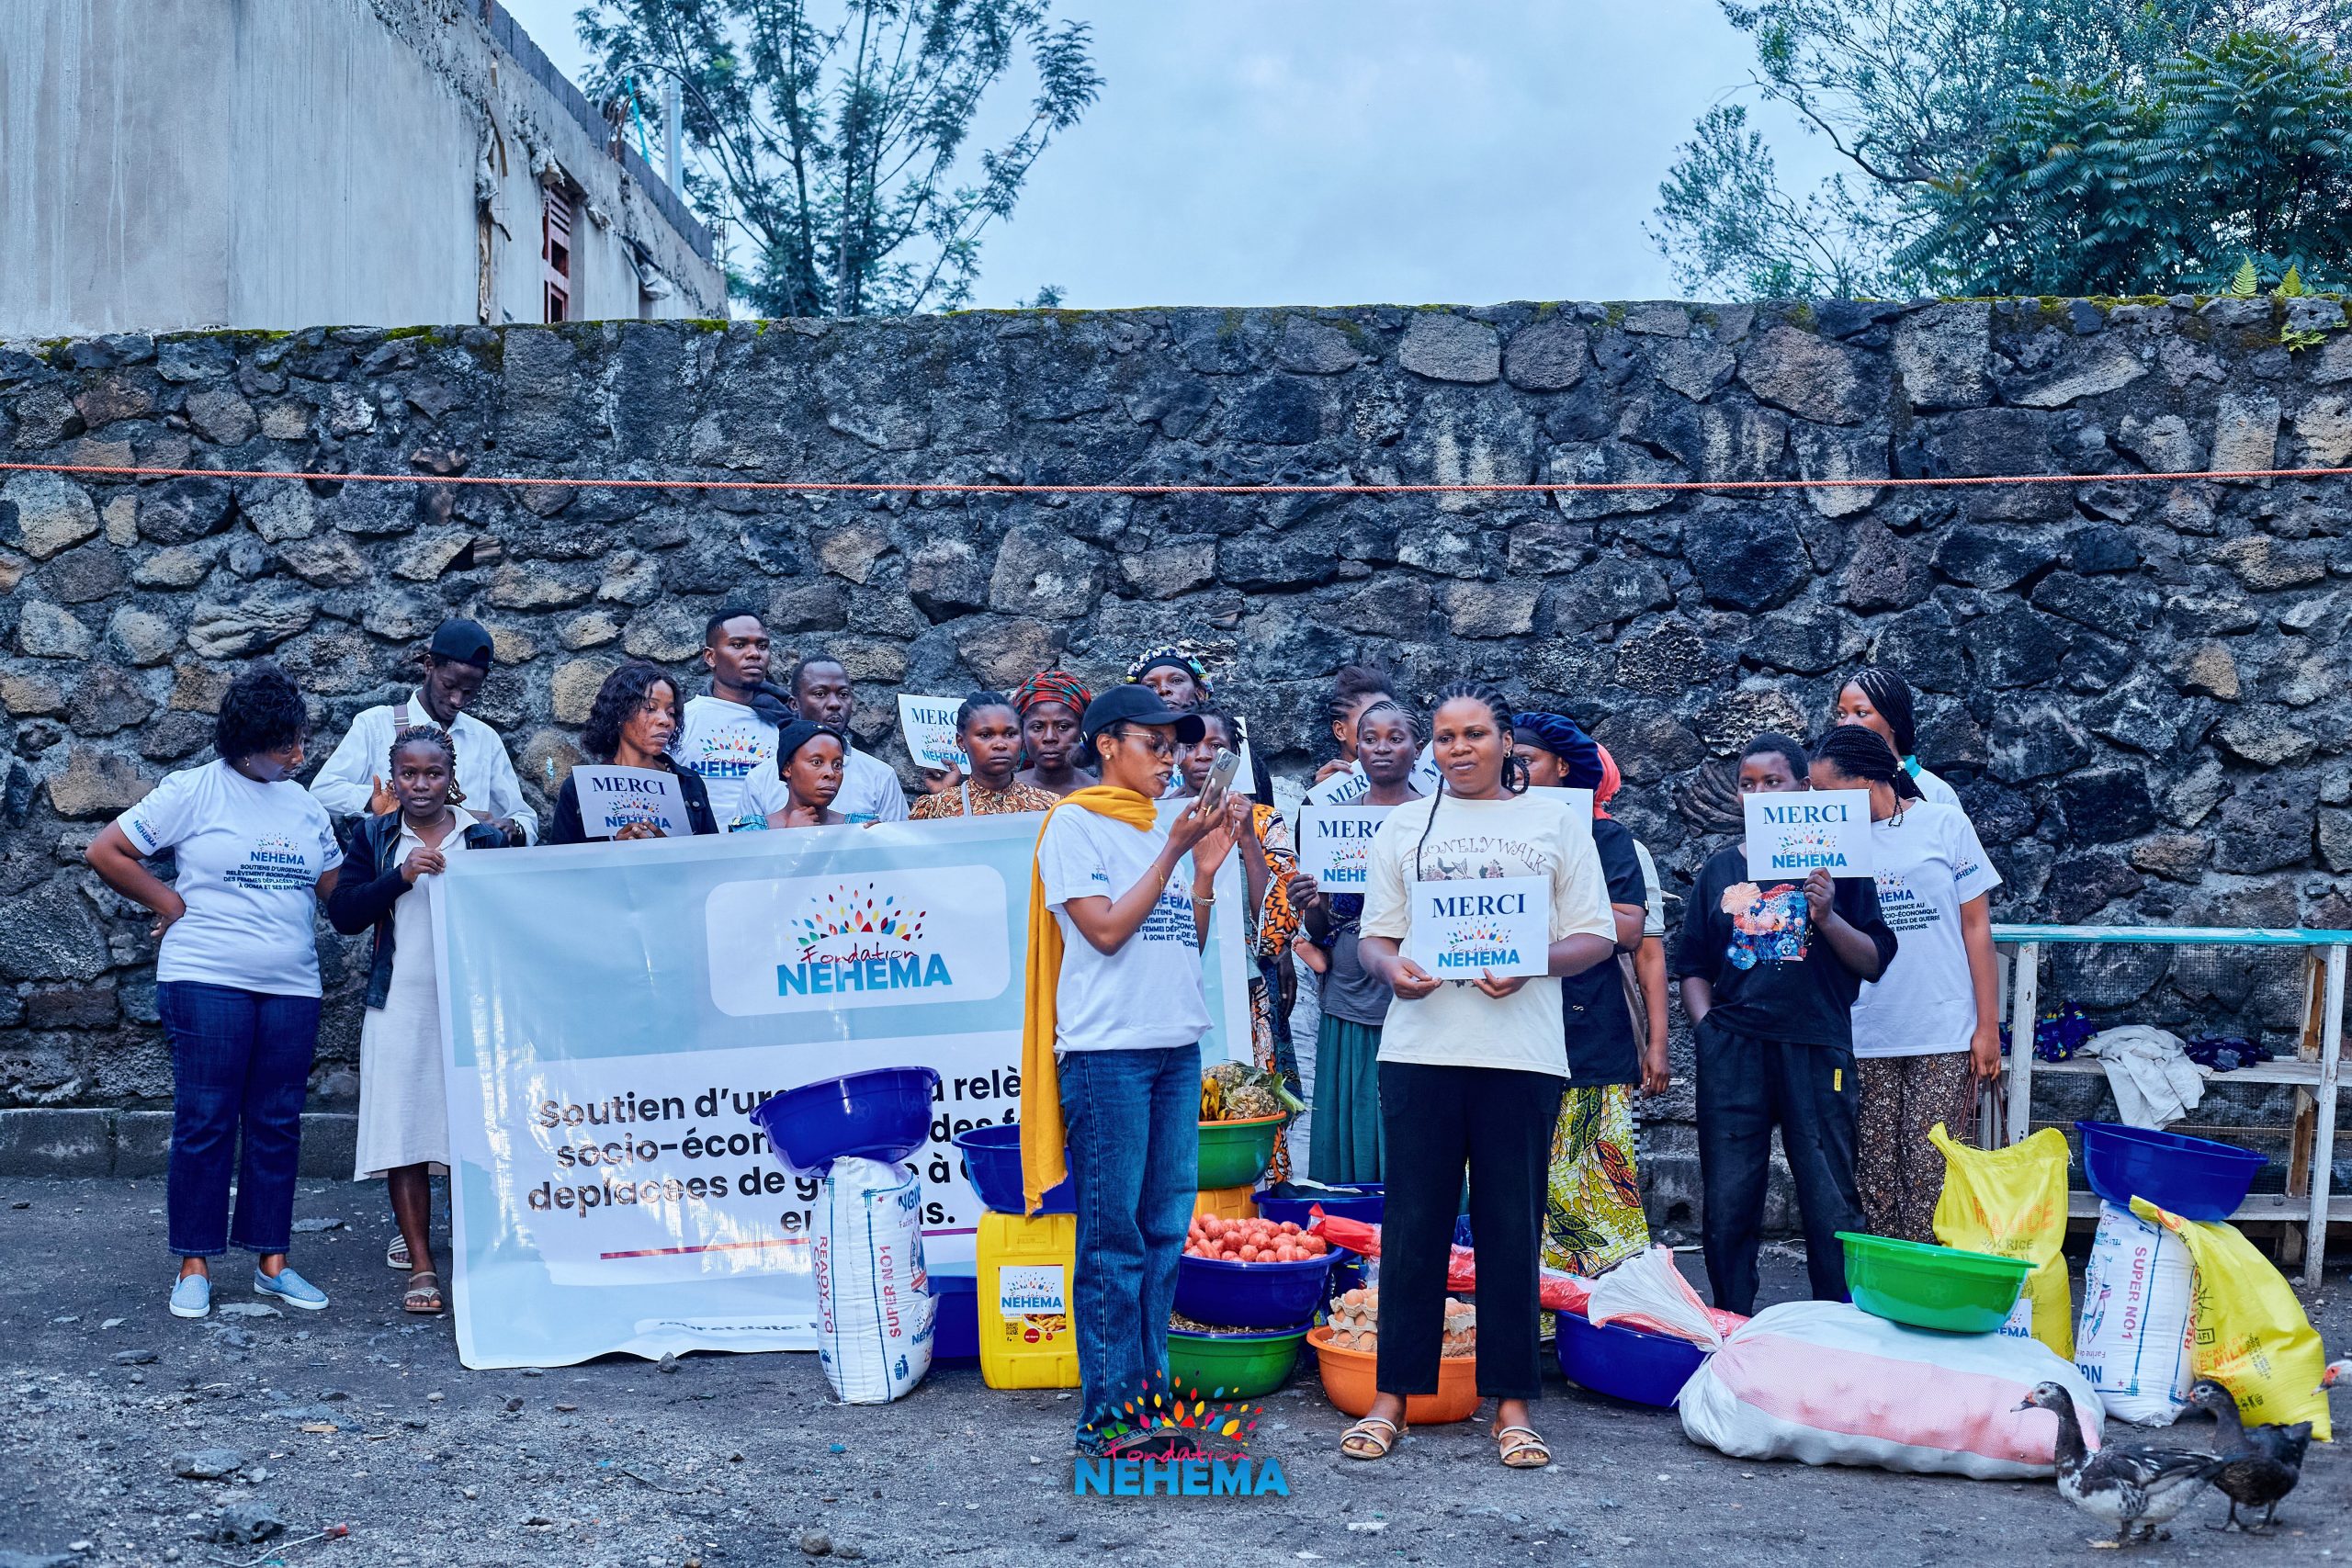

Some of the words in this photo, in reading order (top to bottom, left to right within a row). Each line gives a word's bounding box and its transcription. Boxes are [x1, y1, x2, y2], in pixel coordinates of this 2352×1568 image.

[911, 708, 958, 726] MERC
[592, 777, 667, 795] MERCI
[1327, 774, 1370, 804] MER
[1762, 805, 1849, 824] MERCI
[250, 852, 305, 865] NEHEMA
[1498, 839, 1547, 875] WALK
[1772, 852, 1848, 868] NEHEMA
[1431, 894, 1526, 918] MERCI
[1878, 889, 1915, 903] HEMA
[1886, 916, 1908, 926] LACÉES
[797, 942, 919, 964] Fondation
[1438, 949, 1520, 967] NEHEMA
[776, 953, 953, 996] NEHEMA
[539, 1091, 684, 1128] Soutien
[955, 1066, 1021, 1100] relè
[557, 1127, 773, 1168] socio-écon
[739, 1167, 785, 1196] de
[929, 1152, 951, 1183] à
[820, 1236, 831, 1301] READY
[2127, 1246, 2147, 1302] SUPER
[883, 1285, 902, 1337] SUPER
[1001, 1296, 1063, 1308] NEHEMA
[824, 1308, 833, 1334] TO
[2121, 1305, 2138, 1340] NO1
[2086, 1350, 2106, 1359] Farine
